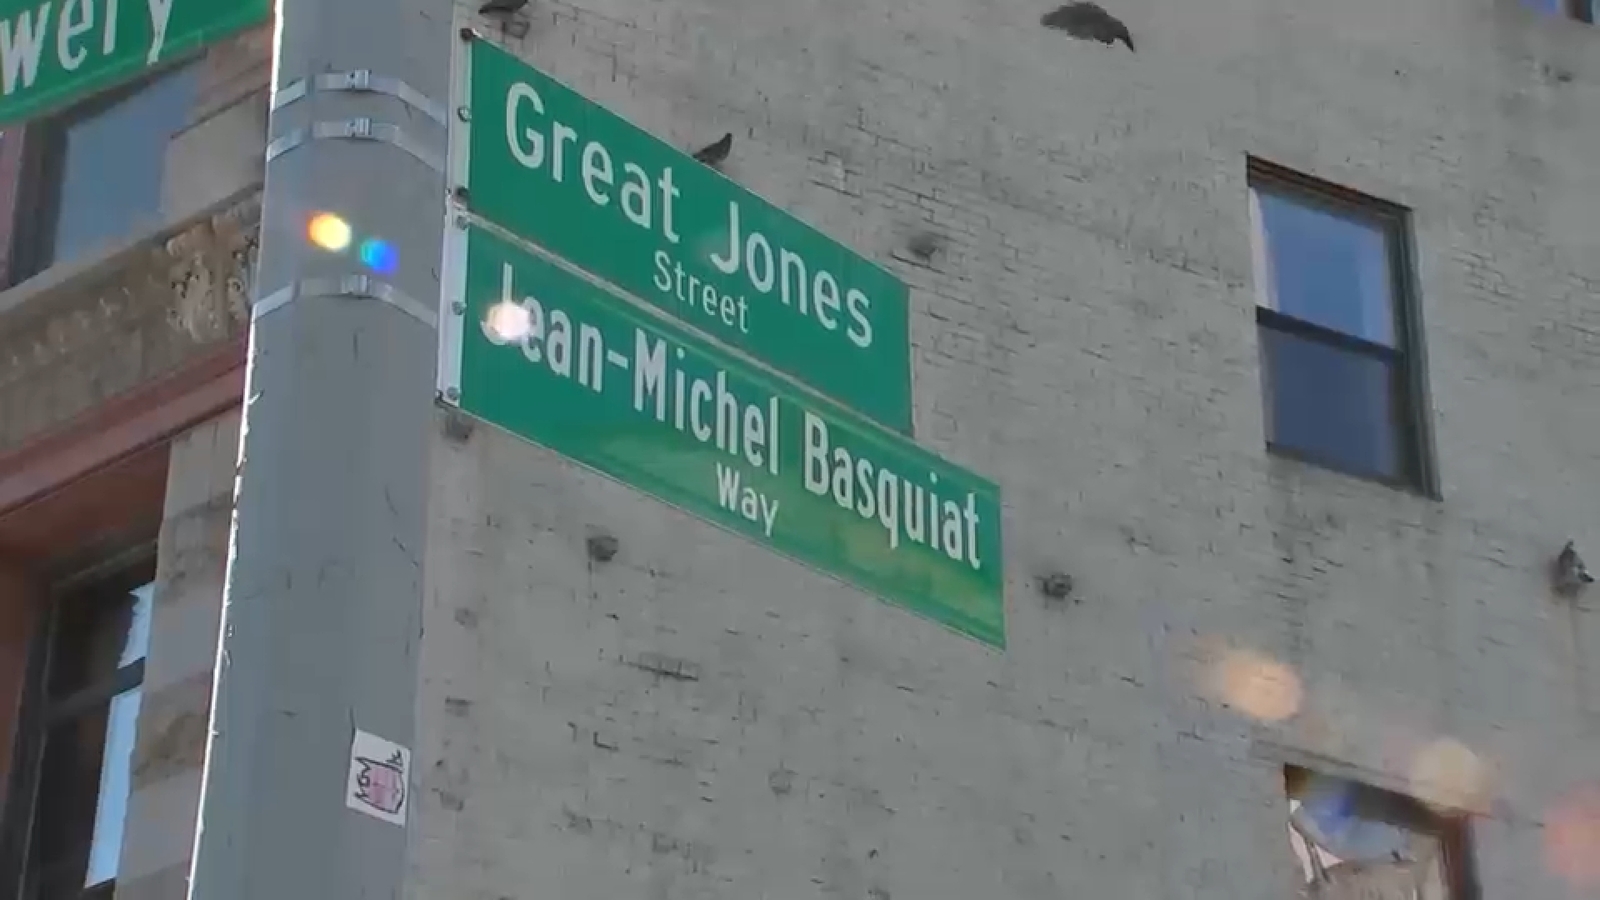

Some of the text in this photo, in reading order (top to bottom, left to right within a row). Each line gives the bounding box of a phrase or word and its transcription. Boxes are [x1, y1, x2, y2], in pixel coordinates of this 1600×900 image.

[505, 82, 874, 348] Great Jones
[653, 250, 749, 334] Street
[480, 263, 982, 570] Jean-Michel Basquiat
[717, 462, 780, 538] Way
